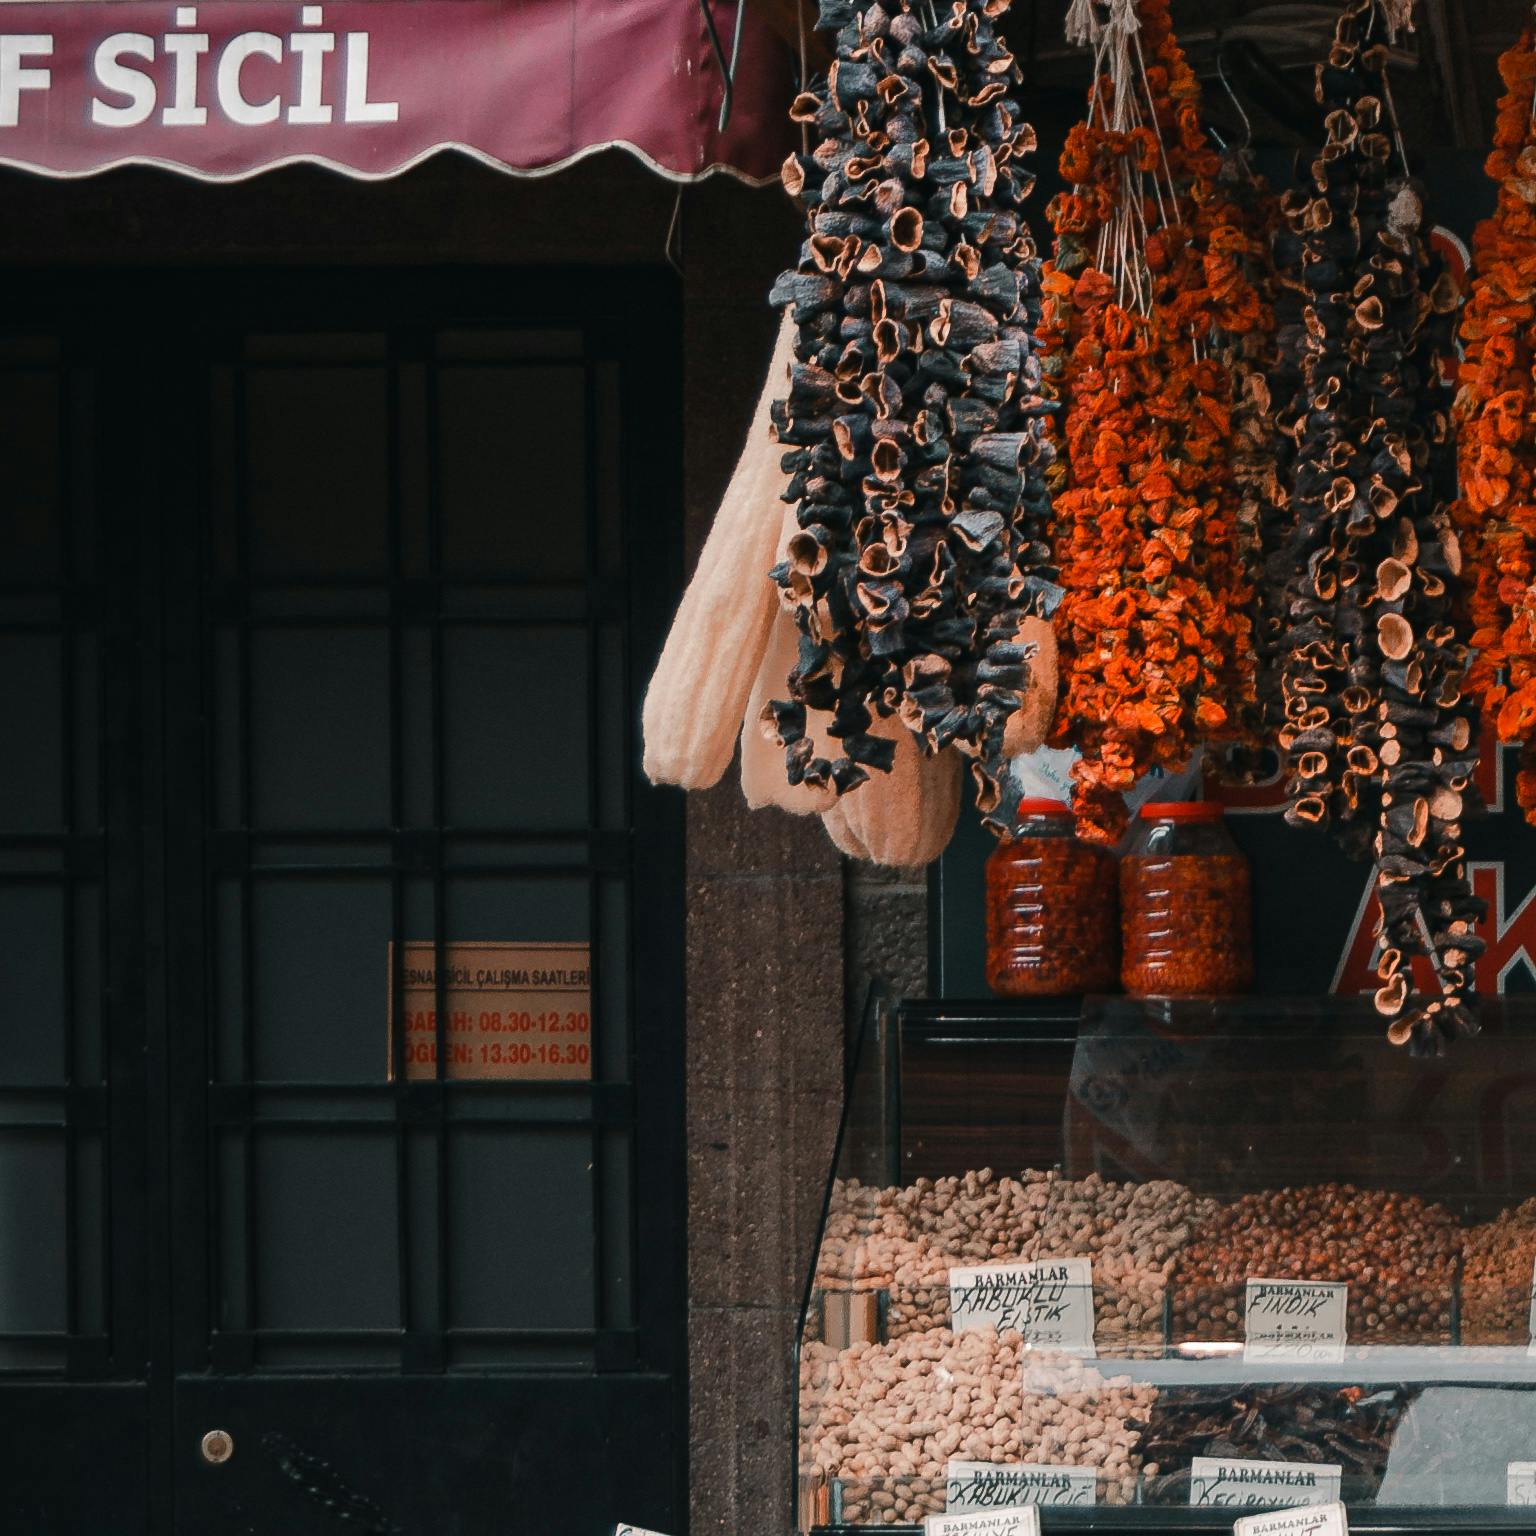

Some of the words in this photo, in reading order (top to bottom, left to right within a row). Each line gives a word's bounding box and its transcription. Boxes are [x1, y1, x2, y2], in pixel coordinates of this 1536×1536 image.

[92, 6, 399, 126] SİCİL
[476, 970, 530, 989] ÇALIŞMA
[479, 1011, 589, 1033] 08.30-12.30
[480, 1043, 589, 1064] 13.30-16.30
[975, 1266, 1069, 1288] BARMANLAR
[1259, 1285, 1335, 1299] BARMANLAR
[973, 1470, 1072, 1489] BARMANLAR
[1217, 1467, 1317, 1487] BARMANLAR
[943, 1516, 1021, 1533] BARMANLAR
[1253, 1514, 1328, 1535] BARMANLAR
